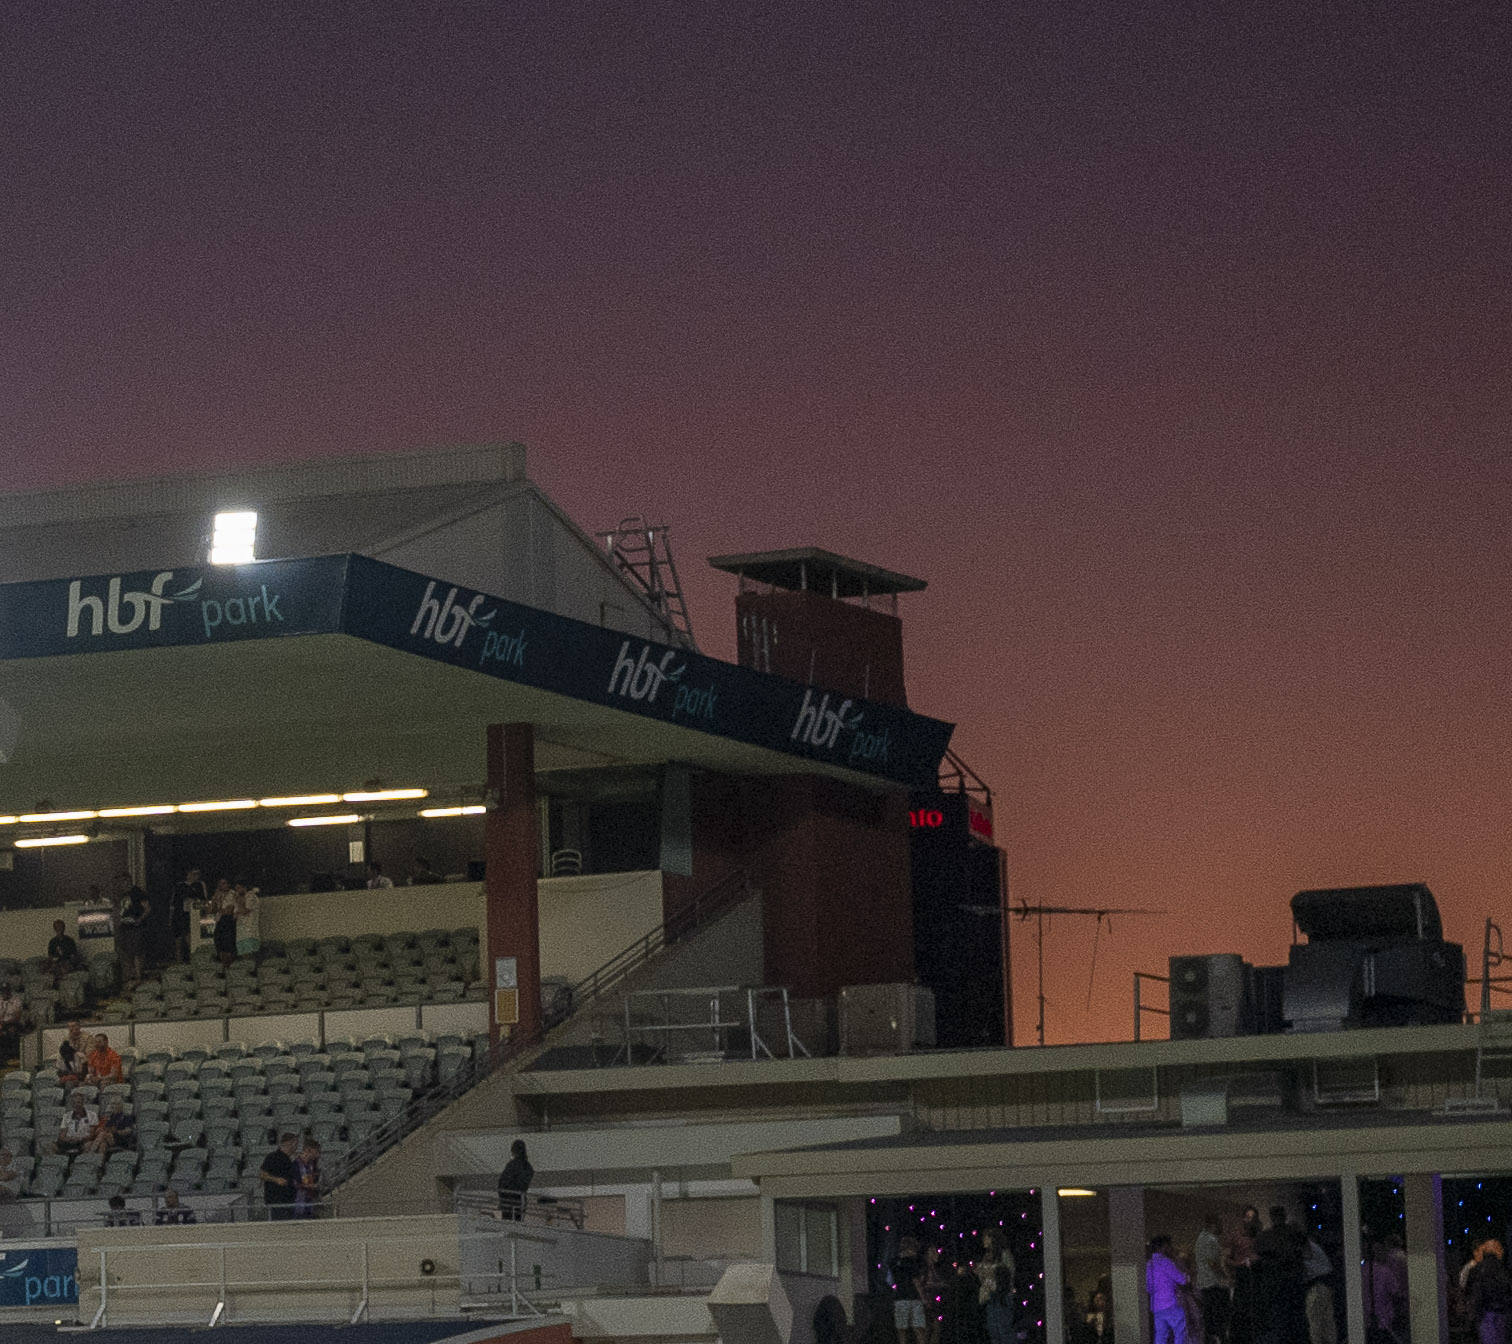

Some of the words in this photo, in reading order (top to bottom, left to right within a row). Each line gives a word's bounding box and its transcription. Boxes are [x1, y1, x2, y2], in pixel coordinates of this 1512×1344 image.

[67, 571, 176, 638] hbf
[201, 585, 284, 639] park
[412, 581, 481, 649] hbf
[482, 623, 528, 668] park
[609, 641, 677, 704] hbf
[673, 676, 719, 721] park
[791, 690, 854, 751] hbf
[850, 720, 893, 763] park
[25, 1269, 78, 1305] par
